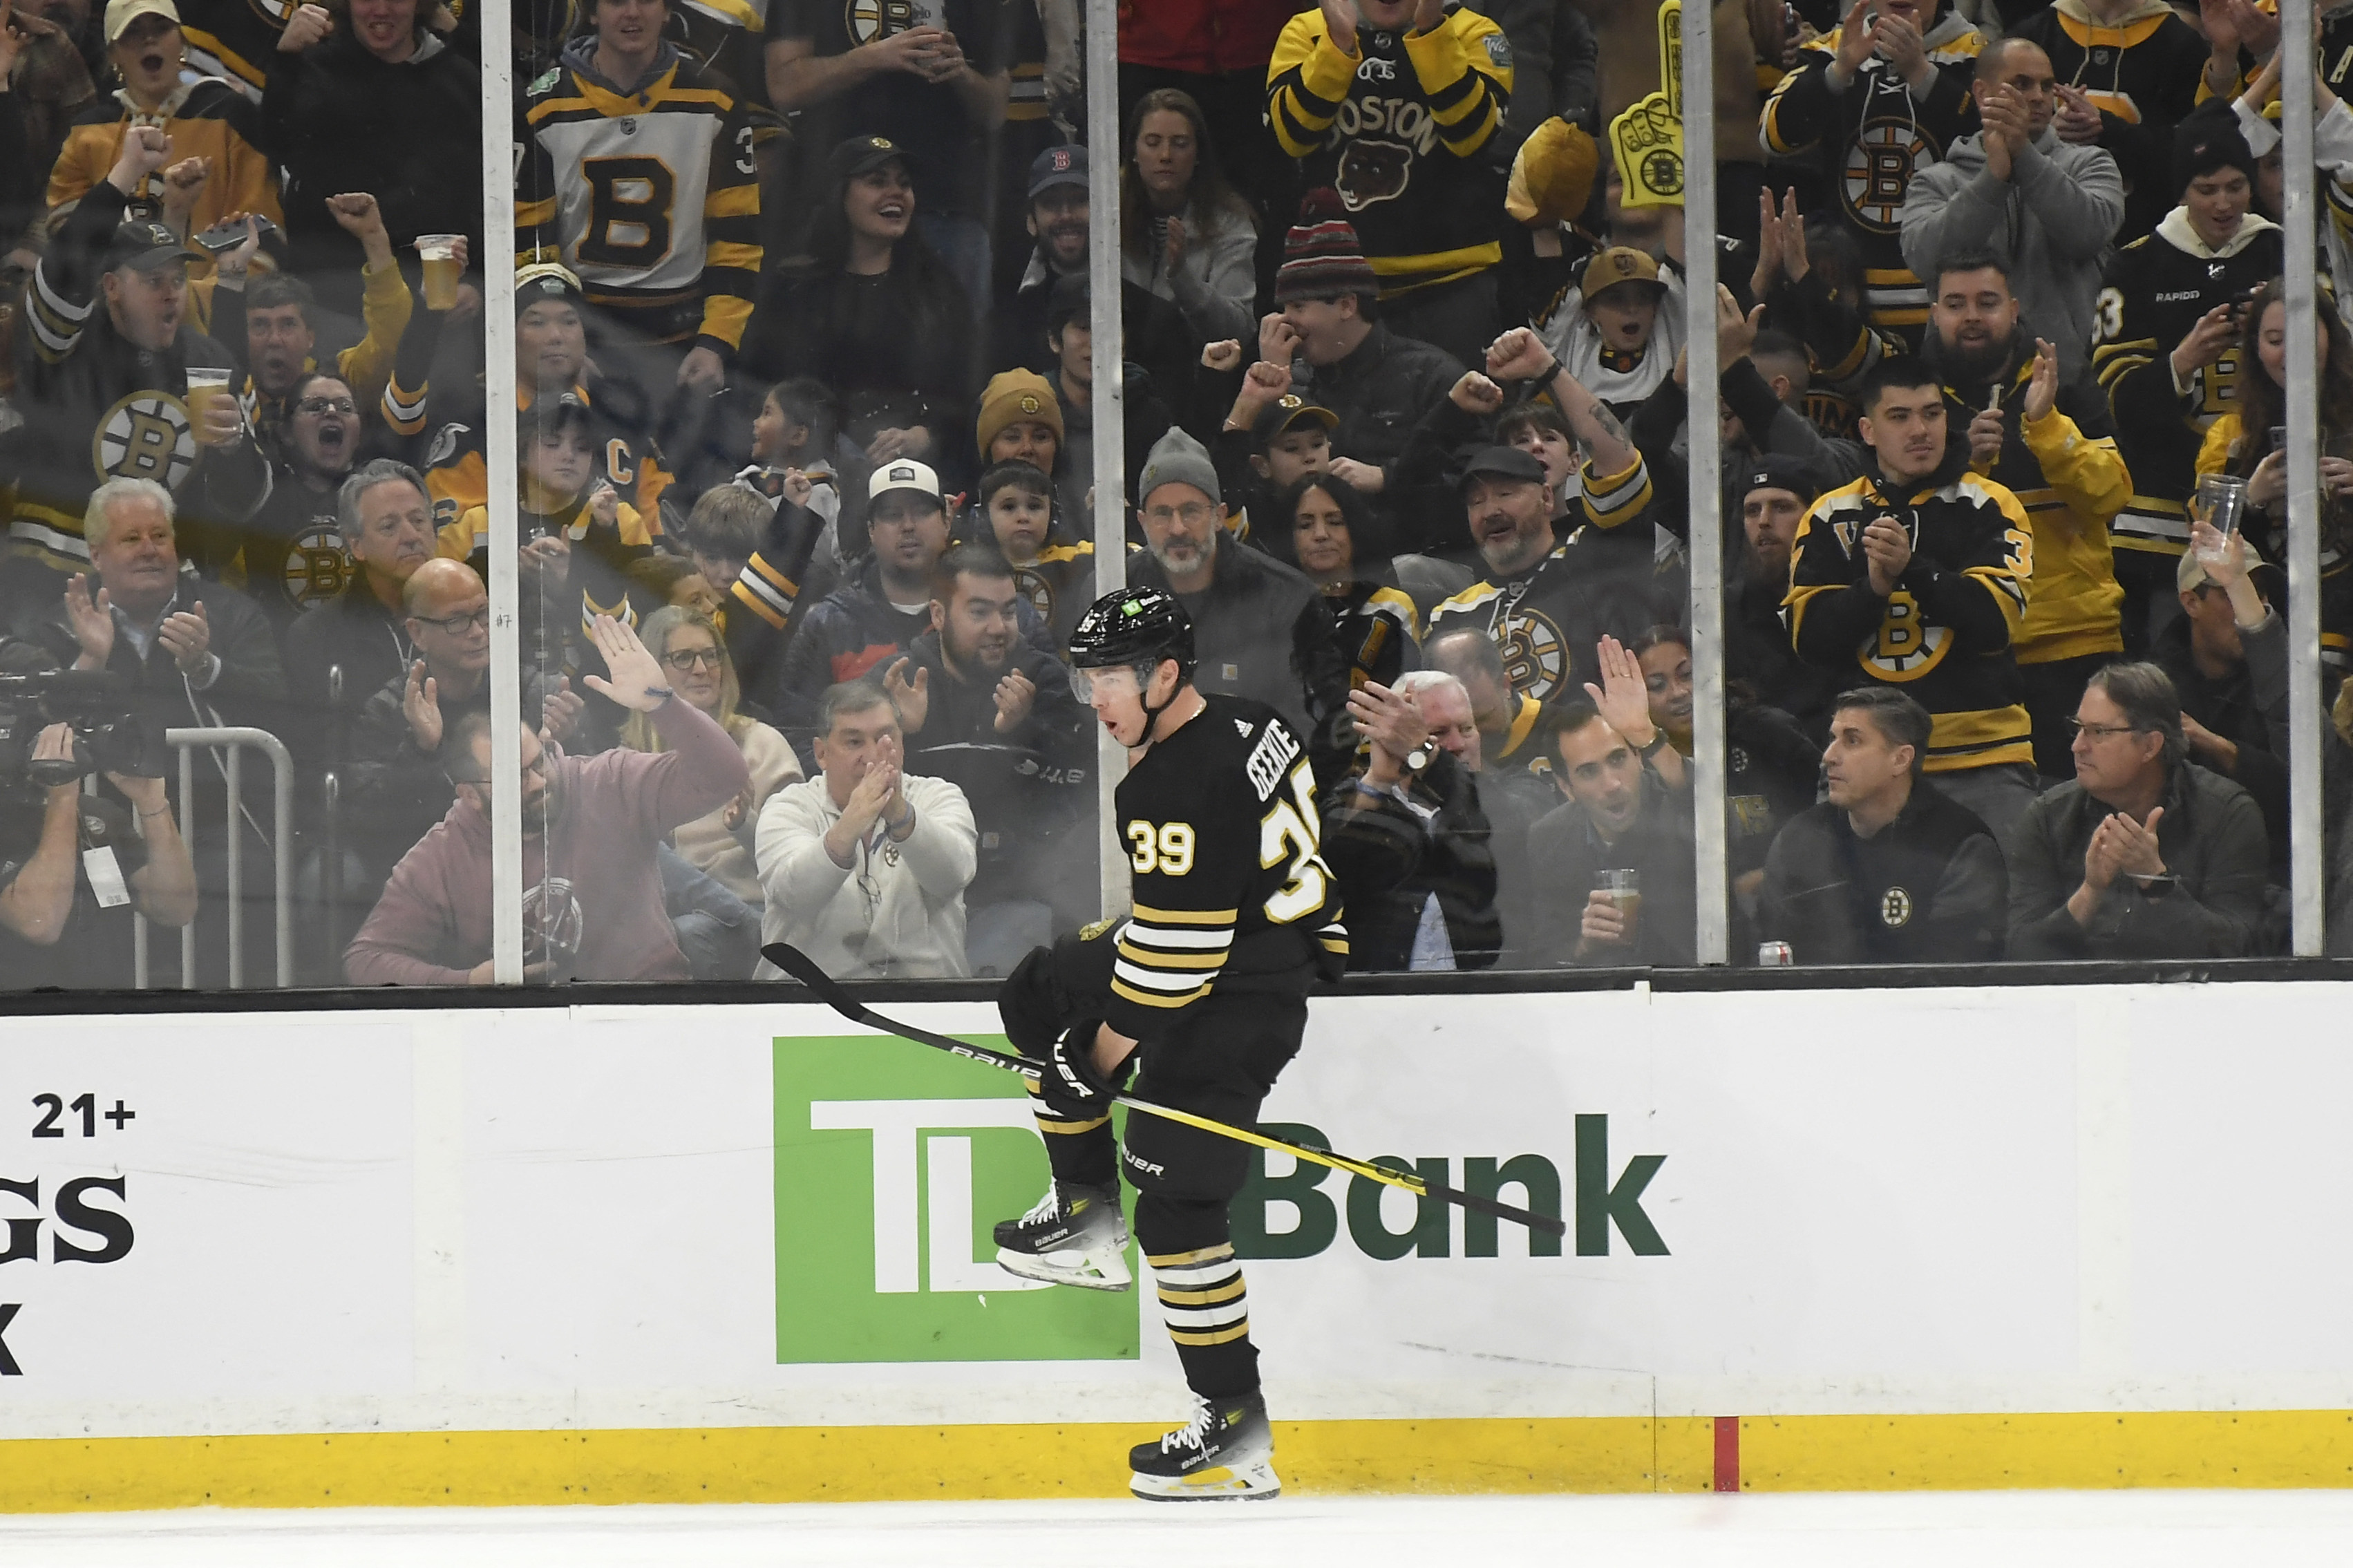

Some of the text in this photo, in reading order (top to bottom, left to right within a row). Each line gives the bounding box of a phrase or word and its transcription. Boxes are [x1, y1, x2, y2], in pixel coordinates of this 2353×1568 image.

[1326, 96, 1438, 156] OSTON
[1052, 151, 1070, 171] B
[1656, 160, 1675, 186] B
[1857, 142, 1913, 207] B
[575, 153, 677, 270] B
[119, 414, 176, 480] B
[606, 437, 633, 485] C
[301, 547, 346, 599] B
[2004, 528, 2033, 577] 3
[1878, 591, 1922, 656] B
[1496, 628, 1542, 692] B
[1246, 718, 1301, 802] GEEKIE
[1127, 820, 1196, 876] 39
[1889, 897, 1902, 917] B
[31, 1093, 135, 1137] 21+
[811, 1099, 1672, 1292] TD Bank
[1034, 1228, 1068, 1247] BAUER
